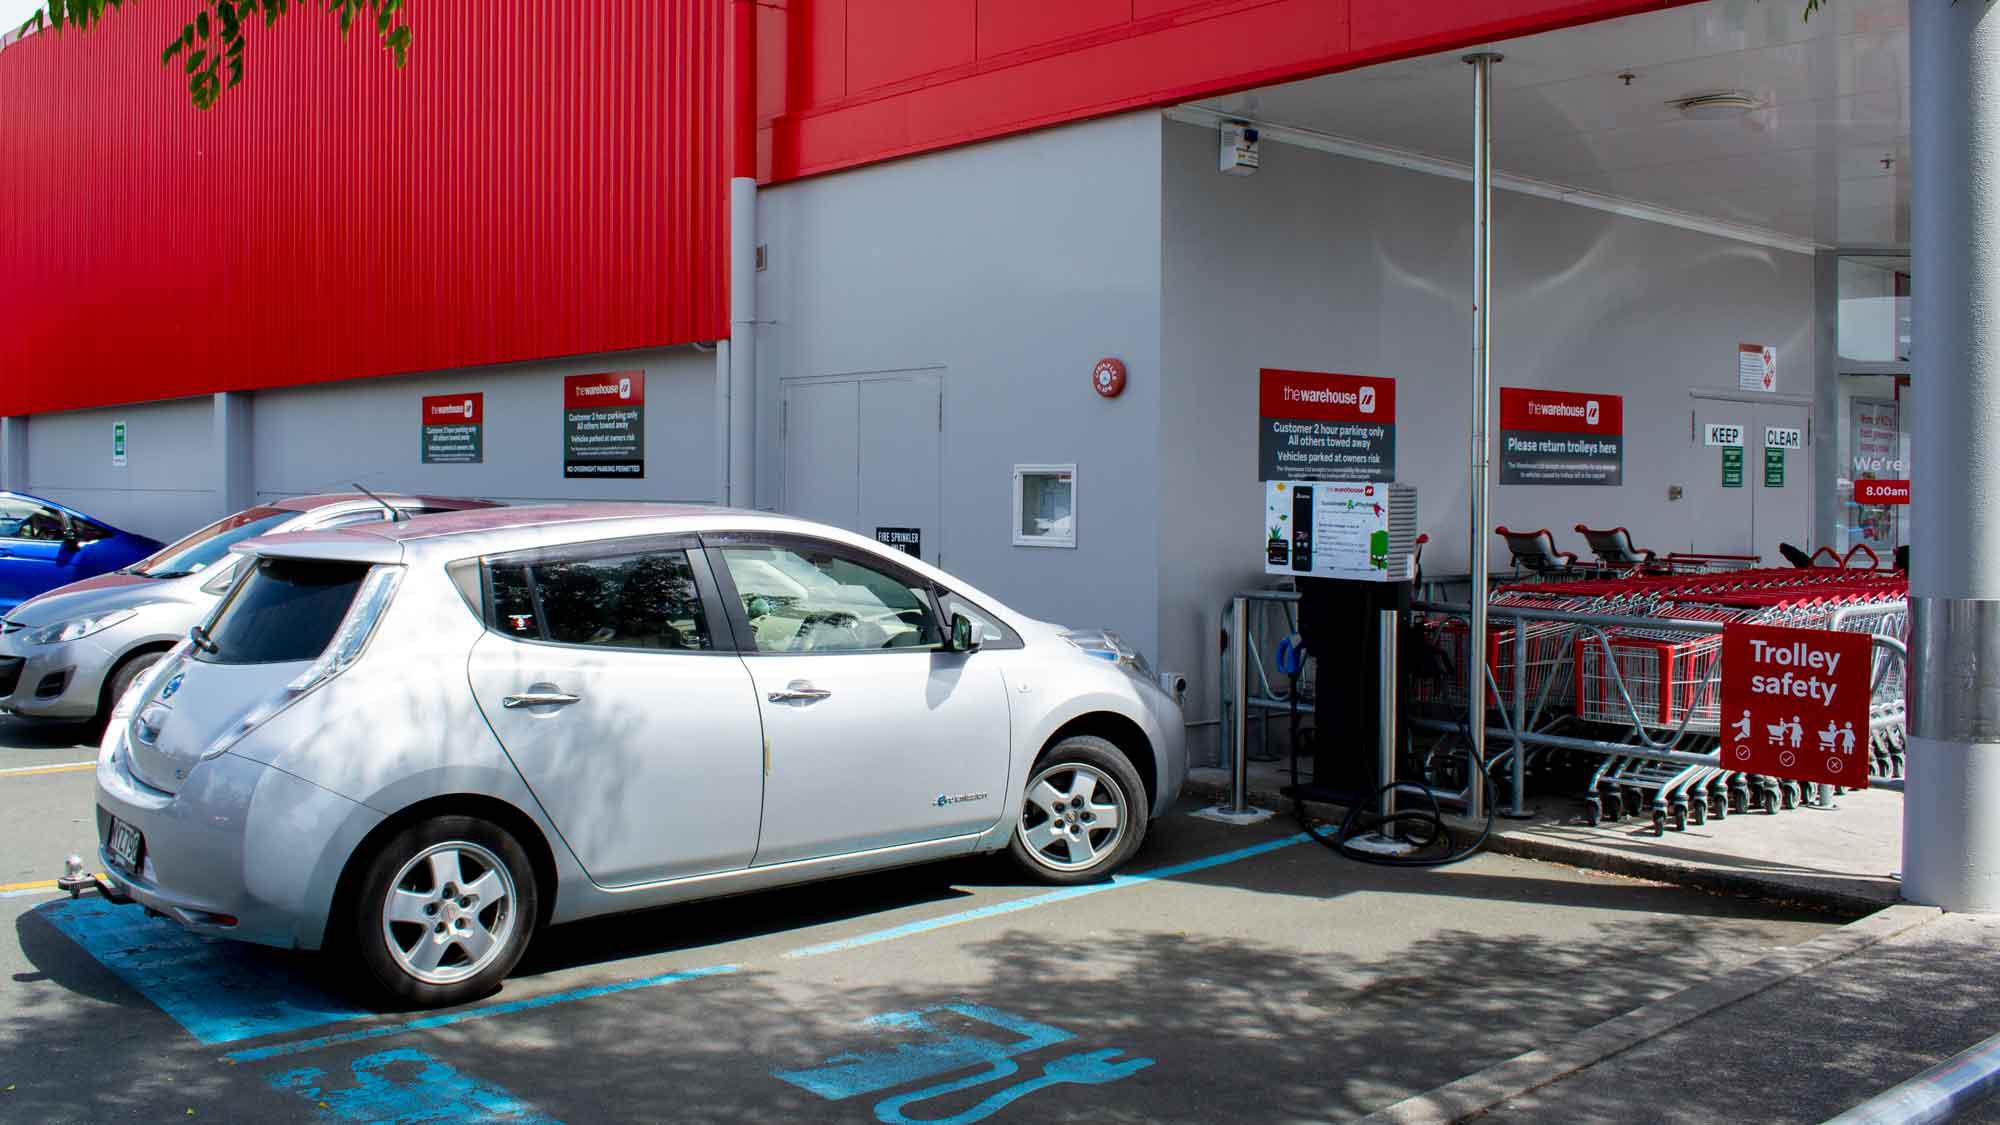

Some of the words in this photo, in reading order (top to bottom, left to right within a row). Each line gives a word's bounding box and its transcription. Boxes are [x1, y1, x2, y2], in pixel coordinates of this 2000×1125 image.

[1284, 386, 1358, 405] thewarehouse
[1528, 401, 1585, 417] thewarehouse
[1273, 422, 1313, 434] Customer
[1314, 423, 1319, 434] 2
[1321, 424, 1338, 435] hour
[1340, 425, 1368, 439] parking
[1369, 428, 1385, 440] only
[1712, 427, 1739, 443] KEEP
[1767, 430, 1799, 446] CLEAR
[1288, 434, 1299, 446] All
[1300, 435, 1325, 447] others
[1327, 437, 1351, 448] towed
[1352, 439, 1372, 452] away
[1508, 438, 1538, 451] Please
[1539, 440, 1566, 453] return
[1567, 440, 1598, 456] trolleys
[1599, 442, 1617, 454] here
[1277, 450, 1307, 461] Vehicles
[1308, 451, 1334, 463] parked
[1335, 453, 1342, 462] at
[1342, 455, 1367, 464] owners
[1367, 454, 1380, 464] risk
[1853, 456, 1903, 471] We're
[1866, 486, 1908, 497] 8.00am
[879, 532, 890, 542] FIRE
[891, 532, 918, 543] SPRINKLER
[1749, 639, 1841, 675] Trolley
[1751, 672, 1838, 706] safety
